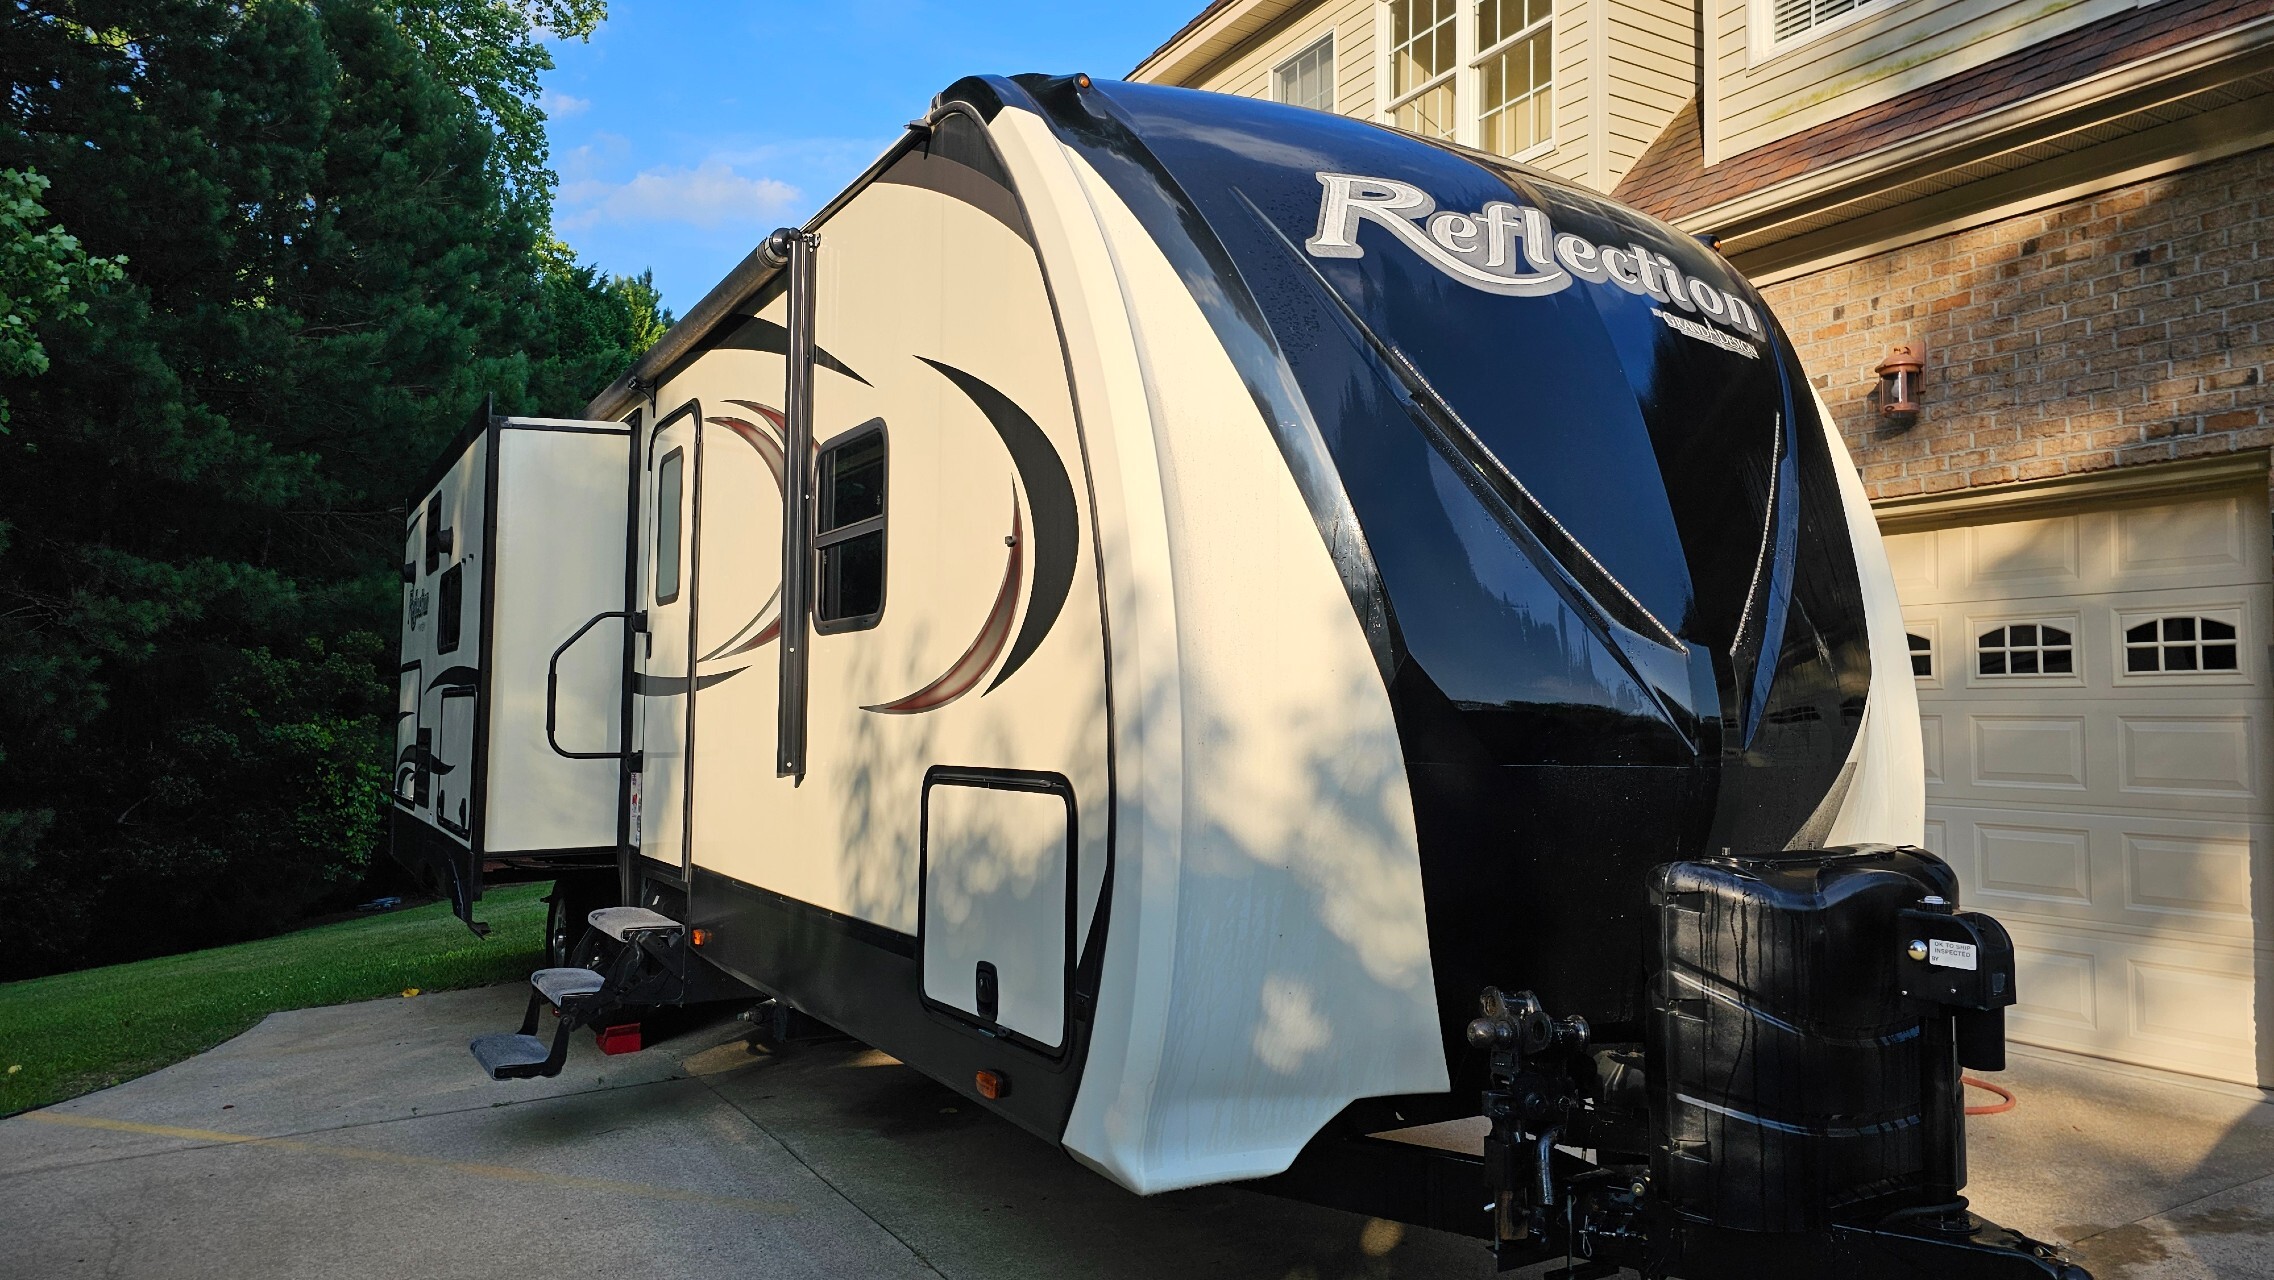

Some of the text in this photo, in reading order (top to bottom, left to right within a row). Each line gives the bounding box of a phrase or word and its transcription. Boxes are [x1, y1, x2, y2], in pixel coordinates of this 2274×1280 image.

[1304, 171, 1766, 342] Reflection
[1662, 311, 1710, 338] GRAND
[1934, 948, 1970, 957] INSPECTED
